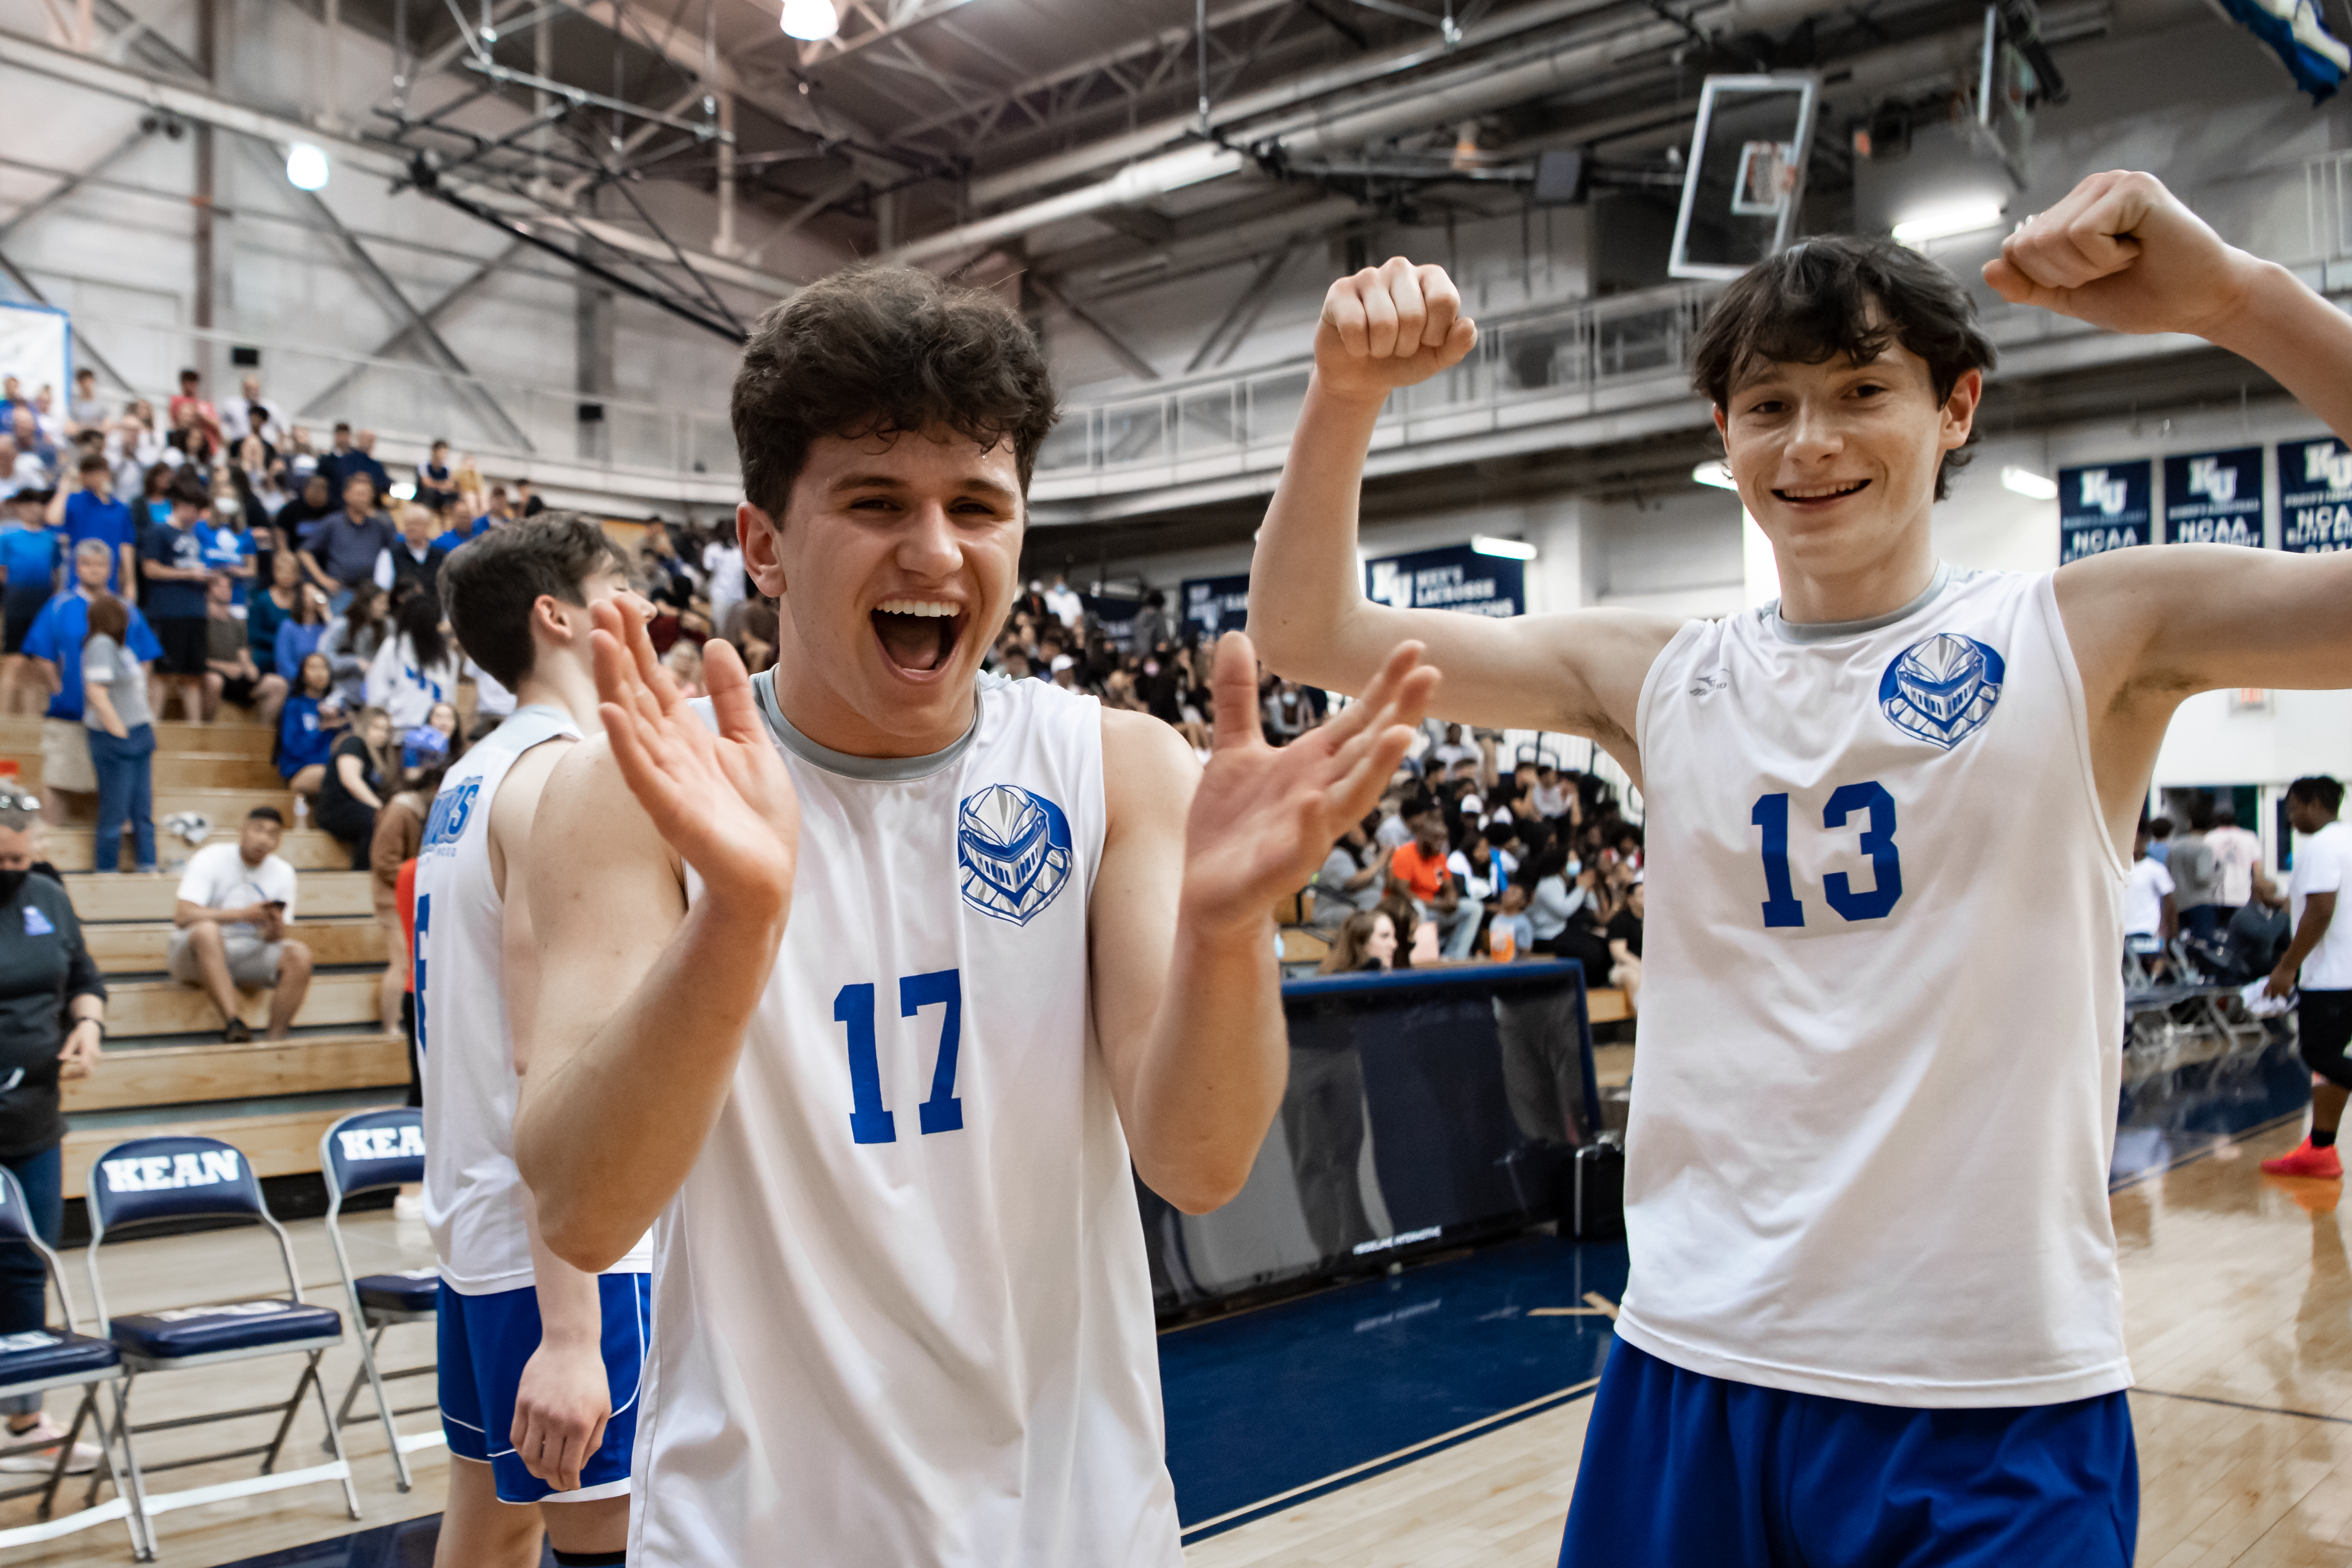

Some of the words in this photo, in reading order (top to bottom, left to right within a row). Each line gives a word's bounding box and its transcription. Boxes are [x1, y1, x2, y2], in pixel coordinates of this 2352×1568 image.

[2188, 456, 2237, 503] KU
[2305, 442, 2352, 488] KU
[2080, 469, 2127, 514] KU
[2072, 526, 2137, 554] NCAA
[2179, 514, 2248, 544] NCAA
[2297, 503, 2352, 540] NCA
[1752, 781, 1902, 927] 13
[834, 969, 963, 1144] 17
[337, 1125, 427, 1161] KEA
[101, 1149, 240, 1192] KEAN
